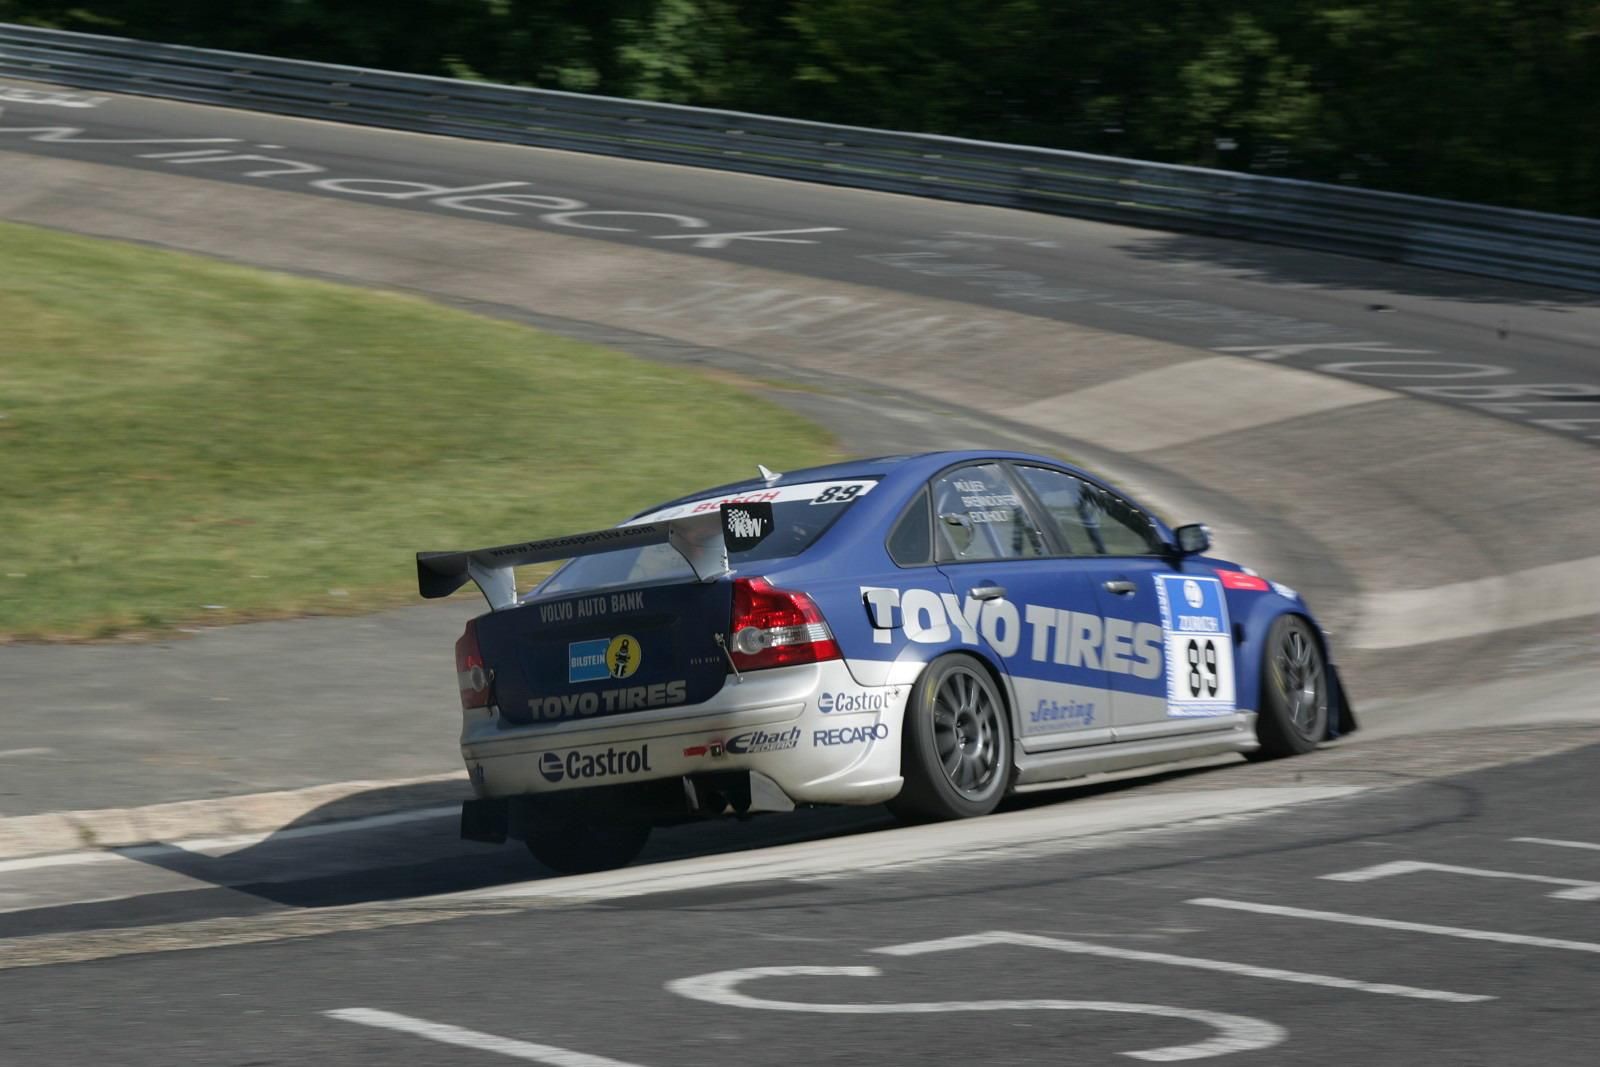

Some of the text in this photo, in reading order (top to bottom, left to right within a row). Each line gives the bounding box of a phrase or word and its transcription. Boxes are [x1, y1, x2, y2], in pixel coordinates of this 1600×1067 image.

[815, 485, 863, 503] 89
[540, 591, 644, 623] VOLVO AUTO BANK
[860, 586, 1020, 658] TOYO
[1025, 604, 1168, 680] TIRES
[571, 654, 605, 668] BILSTEIN
[1188, 639, 1217, 697] 89
[528, 680, 687, 720] TOYO TIRES
[835, 691, 889, 711] Castrol
[813, 723, 889, 747] RECARO
[566, 744, 652, 779] Castrol
